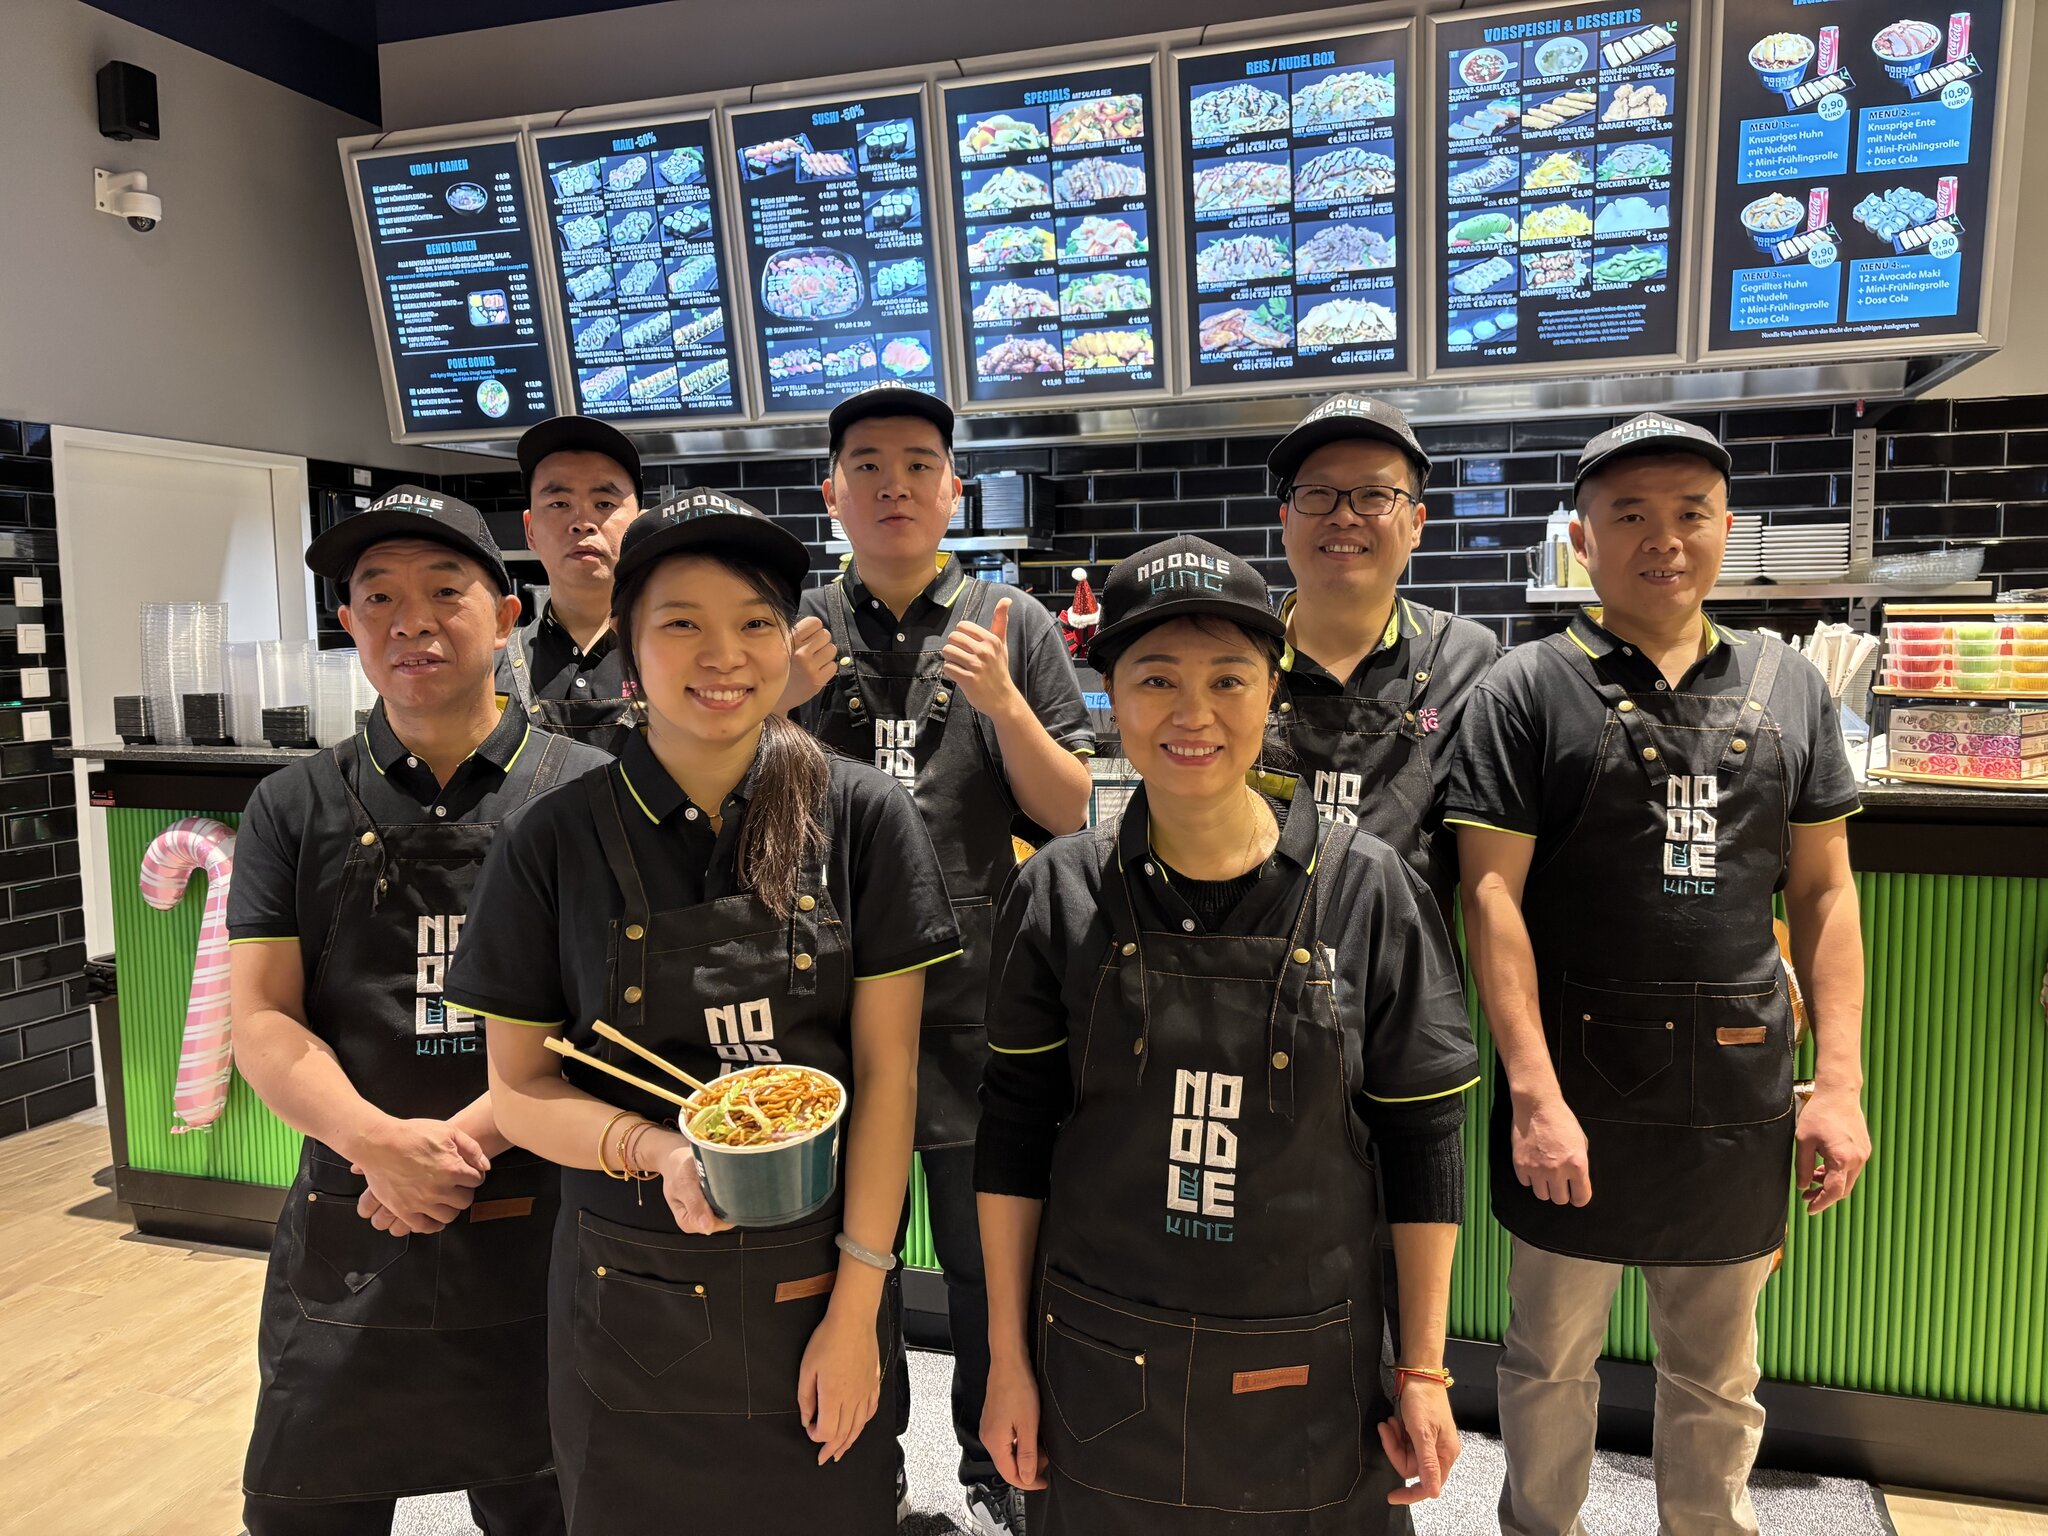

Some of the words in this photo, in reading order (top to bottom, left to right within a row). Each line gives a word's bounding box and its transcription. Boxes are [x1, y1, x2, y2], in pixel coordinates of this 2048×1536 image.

[1484, 23, 1560, 42] VORSPEISEN
[1565, 20, 1574, 31] &
[1577, 9, 1641, 28] DESSERTS
[1246, 60, 1270, 75] REIS
[1279, 54, 1312, 71] NUDEL
[1314, 51, 1335, 66] BOX
[1523, 78, 1541, 87] MISO
[1542, 75, 1565, 84] SUPPE
[1600, 75, 1622, 83] ROLLE
[1024, 88, 1071, 105] SPECIALS
[1449, 94, 1470, 102] SUPPE
[1943, 86, 1970, 100] 10,90
[1821, 99, 1843, 112] 9,90
[812, 111, 839, 126] SUSHI
[840, 104, 865, 121] -50%
[1824, 110, 1841, 119] EURO
[1598, 122, 1625, 131] KARAGE
[1626, 118, 1656, 127] CHICKEN
[1868, 122, 1914, 131] Knusprige
[1916, 119, 1936, 127] Ente
[1522, 130, 1553, 140] TEMPURA
[1553, 126, 1588, 136] GARNELEN
[1749, 133, 1797, 145] Knuspriges
[1799, 130, 1824, 139] Huhn
[1867, 135, 1882, 143] mit
[1884, 132, 1917, 142] Nudeln
[612, 139, 635, 152] MAKI
[1105, 139, 1127, 147] TELLER
[1448, 139, 1474, 148] WARME
[1475, 136, 1502, 144] ROLLEN
[1874, 139, 1960, 154] Mini-Frühlingsrolle
[1748, 147, 1763, 156] mit
[1765, 144, 1797, 154] Nudeln
[977, 153, 997, 162] TELLER
[1755, 151, 1838, 167] Mini-Frühlingsrolle
[1874, 157, 1896, 166] Dose
[1898, 155, 1918, 163] Cola
[409, 163, 433, 176] UDON
[440, 159, 469, 172] RAMEN
[1755, 170, 1776, 178] Dose
[1778, 167, 1798, 175] Cola
[1596, 180, 1627, 189] CHICKEN
[1628, 177, 1650, 186] SALAT
[1521, 187, 1548, 197] MANGO
[1549, 186, 1570, 194] SALAT
[1070, 200, 1091, 208] TELLER
[426, 242, 451, 255] BENTO
[451, 240, 477, 252] BOXEN
[1448, 245, 1481, 254] AVOCADO
[1932, 238, 1955, 250] 9,90
[1811, 247, 1833, 259] 9,90
[1859, 275, 1870, 283] 12
[1878, 271, 1917, 281] Avocado
[1919, 269, 1941, 278] Maki
[1593, 282, 1628, 291] EDAMAME
[1741, 281, 1782, 293] Gegrilltes
[1784, 280, 1808, 289] Huhn
[1866, 280, 1950, 293] Mini-Frühlingsrolle
[1740, 295, 1755, 303] mit
[1756, 292, 1788, 302] Nudeln
[1865, 296, 1887, 305] Dose
[1889, 294, 1908, 303] Cola
[1747, 300, 1829, 314] Mini-Frühlingsrolle
[1747, 316, 1768, 325] Dose
[1770, 314, 1789, 322] Cola
[447, 358, 468, 369] POKE
[468, 356, 495, 368] BOWLS
[1138, 553, 1230, 582] NOODLE
[1151, 570, 1223, 595] KING
[1663, 879, 1715, 895] KING
[416, 1037, 476, 1055] KING
[1166, 1215, 1233, 1242] KING
